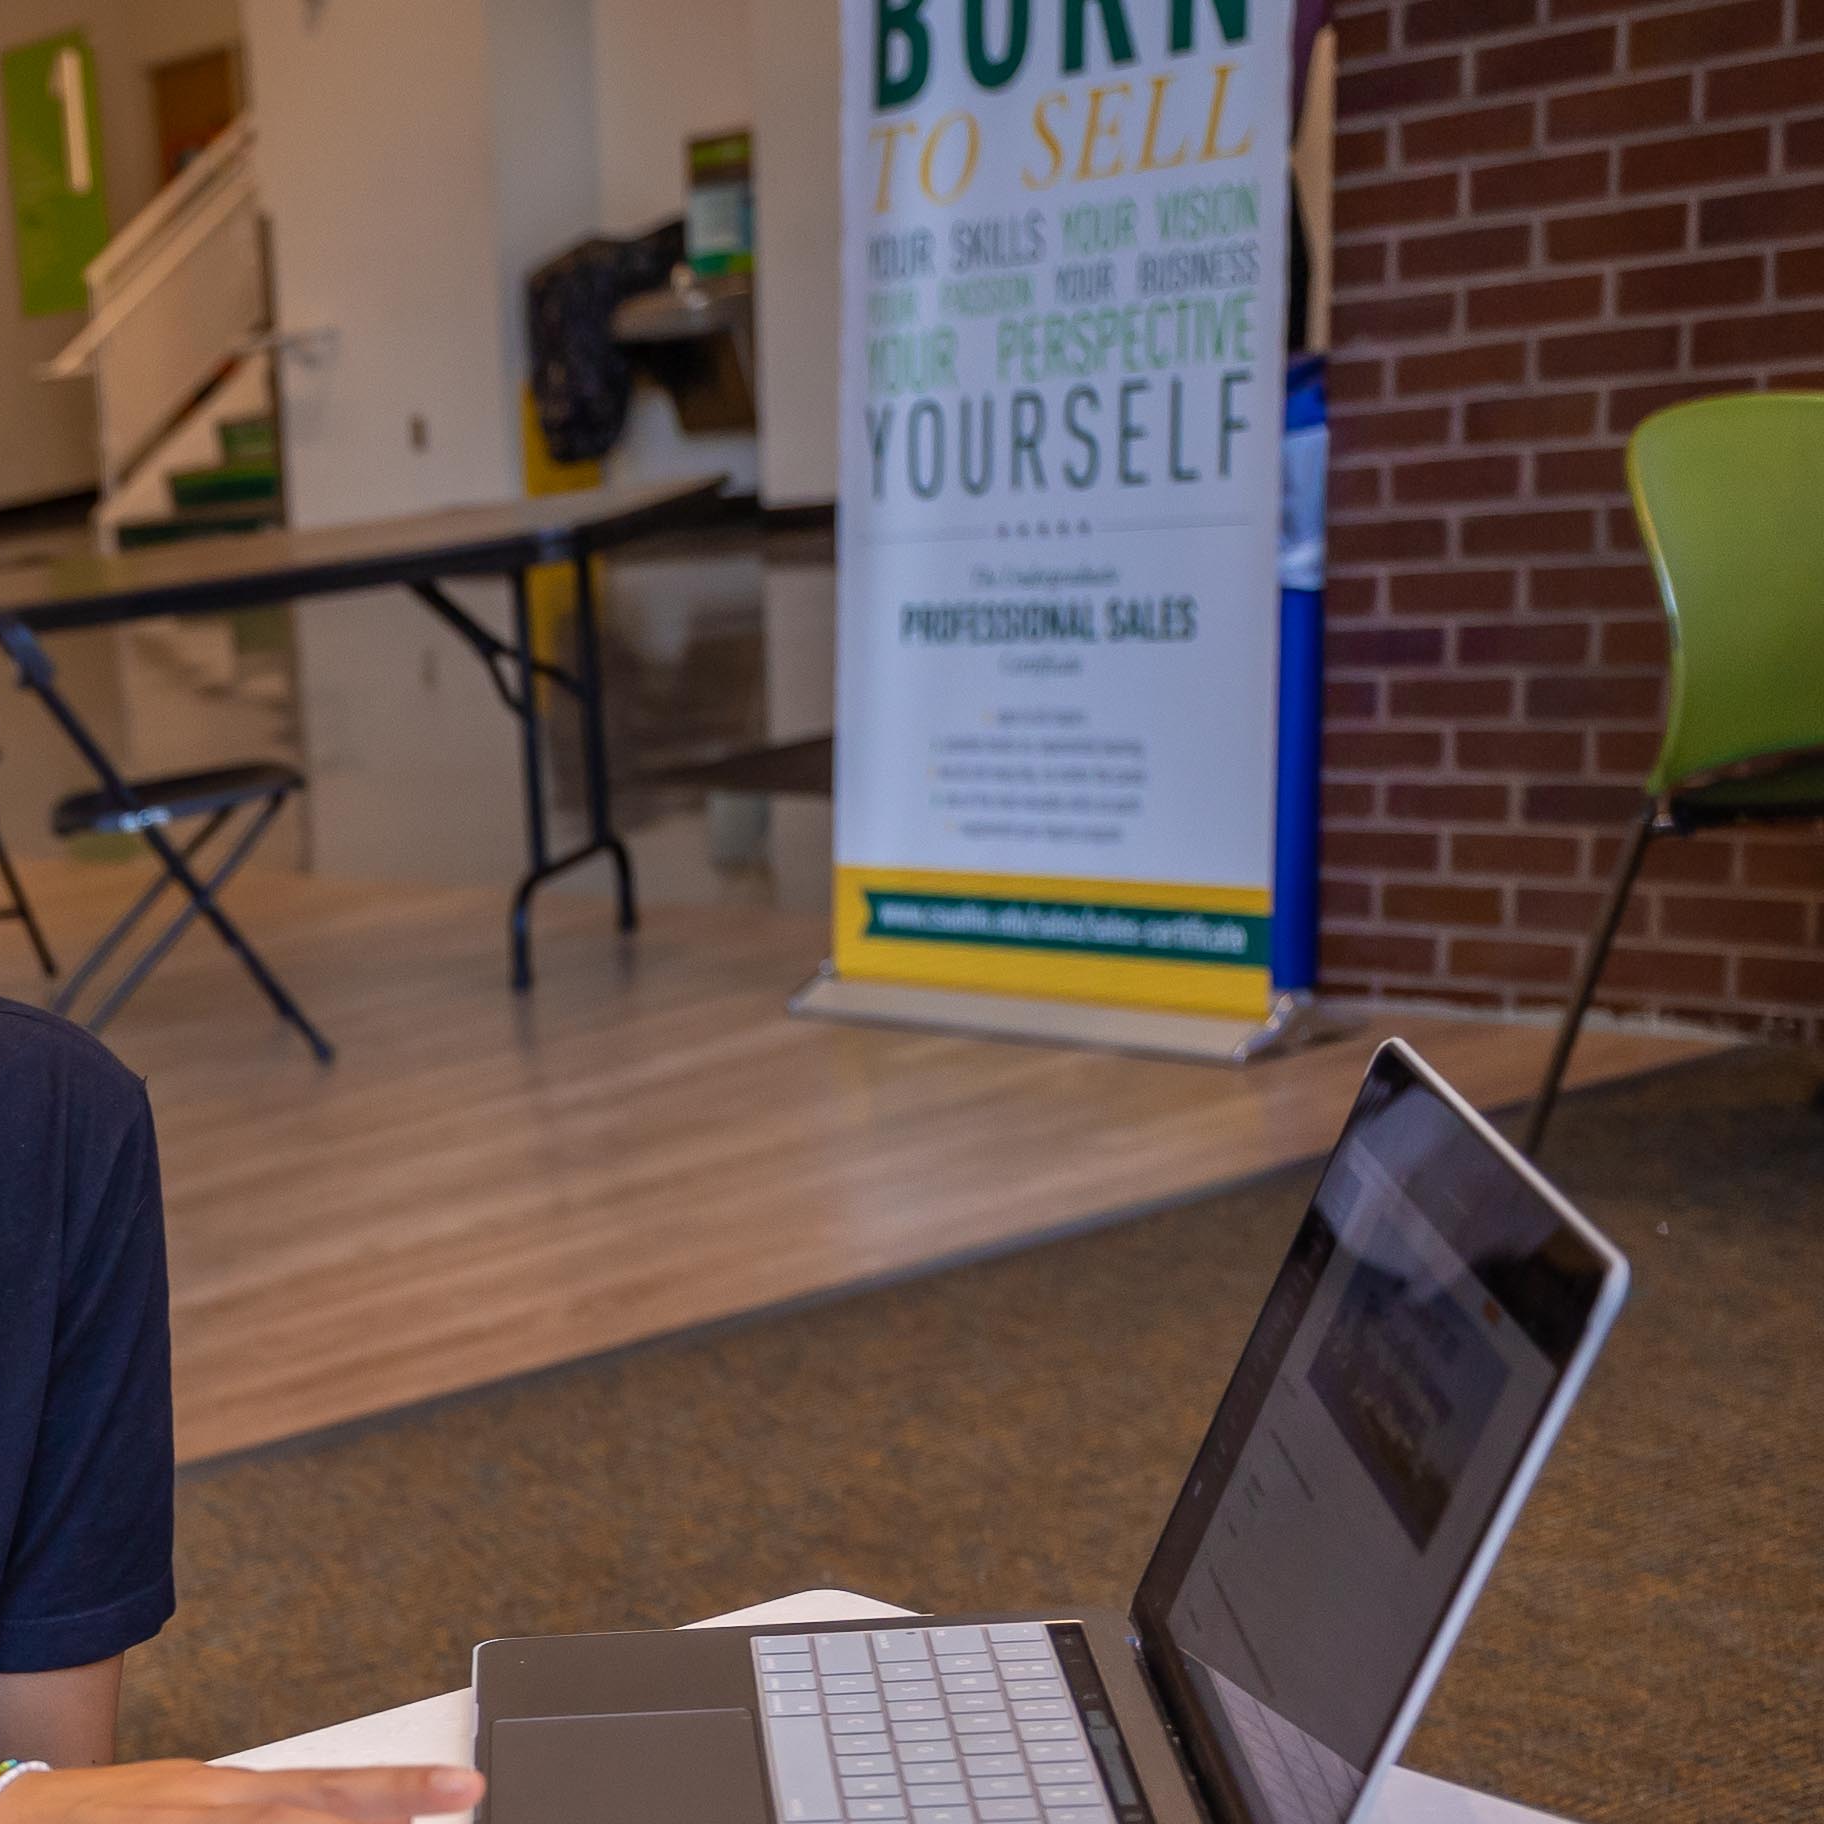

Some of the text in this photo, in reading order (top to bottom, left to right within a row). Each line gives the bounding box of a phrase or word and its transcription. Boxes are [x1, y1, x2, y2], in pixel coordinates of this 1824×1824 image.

[871, 0, 1251, 114] BO
[49, 48, 93, 194] 1
[868, 63, 1253, 214] TO SELL
[950, 208, 1047, 273] SKILLS
[1059, 196, 1138, 254] YOUR
[1156, 183, 1260, 241] VISION
[1138, 239, 1261, 296] BUSINESS
[997, 290, 1257, 384] PERSPECTIVE
[865, 371, 1253, 501] YOURSELF
[900, 595, 1198, 646] PROFESSIONAL SALES
